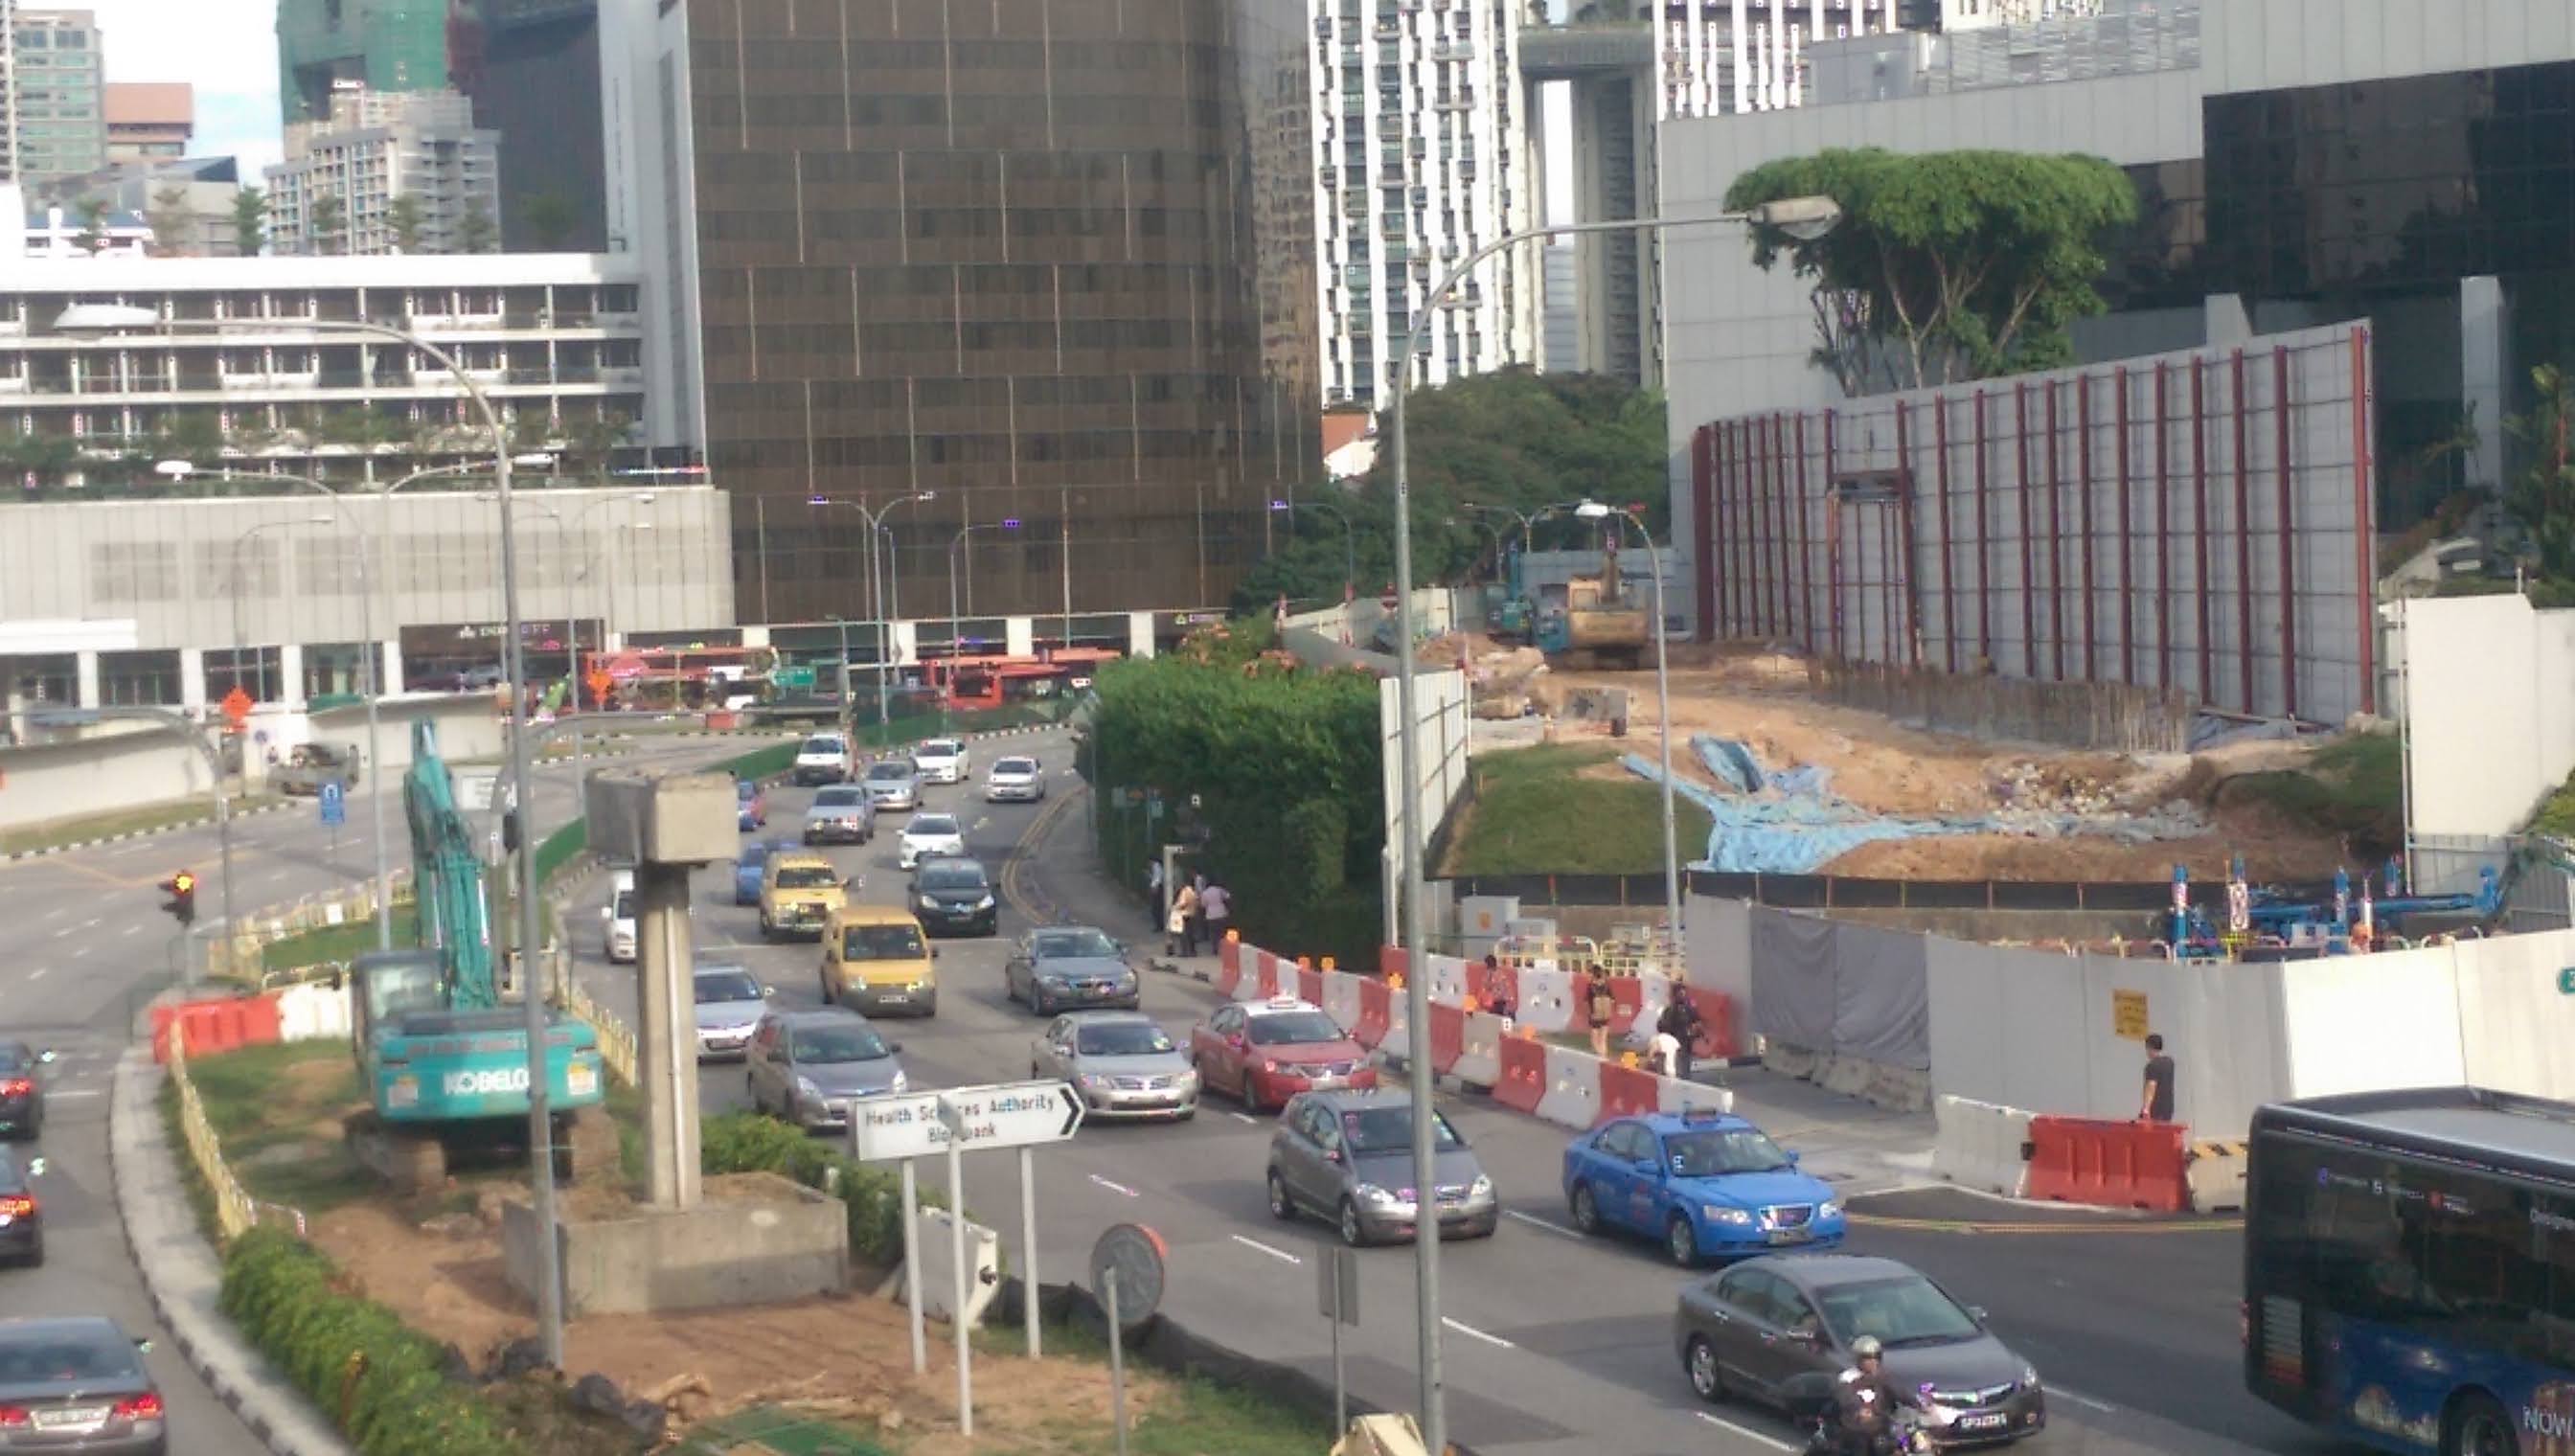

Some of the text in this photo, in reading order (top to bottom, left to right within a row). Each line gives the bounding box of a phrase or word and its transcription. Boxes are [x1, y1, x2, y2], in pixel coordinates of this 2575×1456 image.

[866, 1092, 1055, 1127] Health Sces Authority
